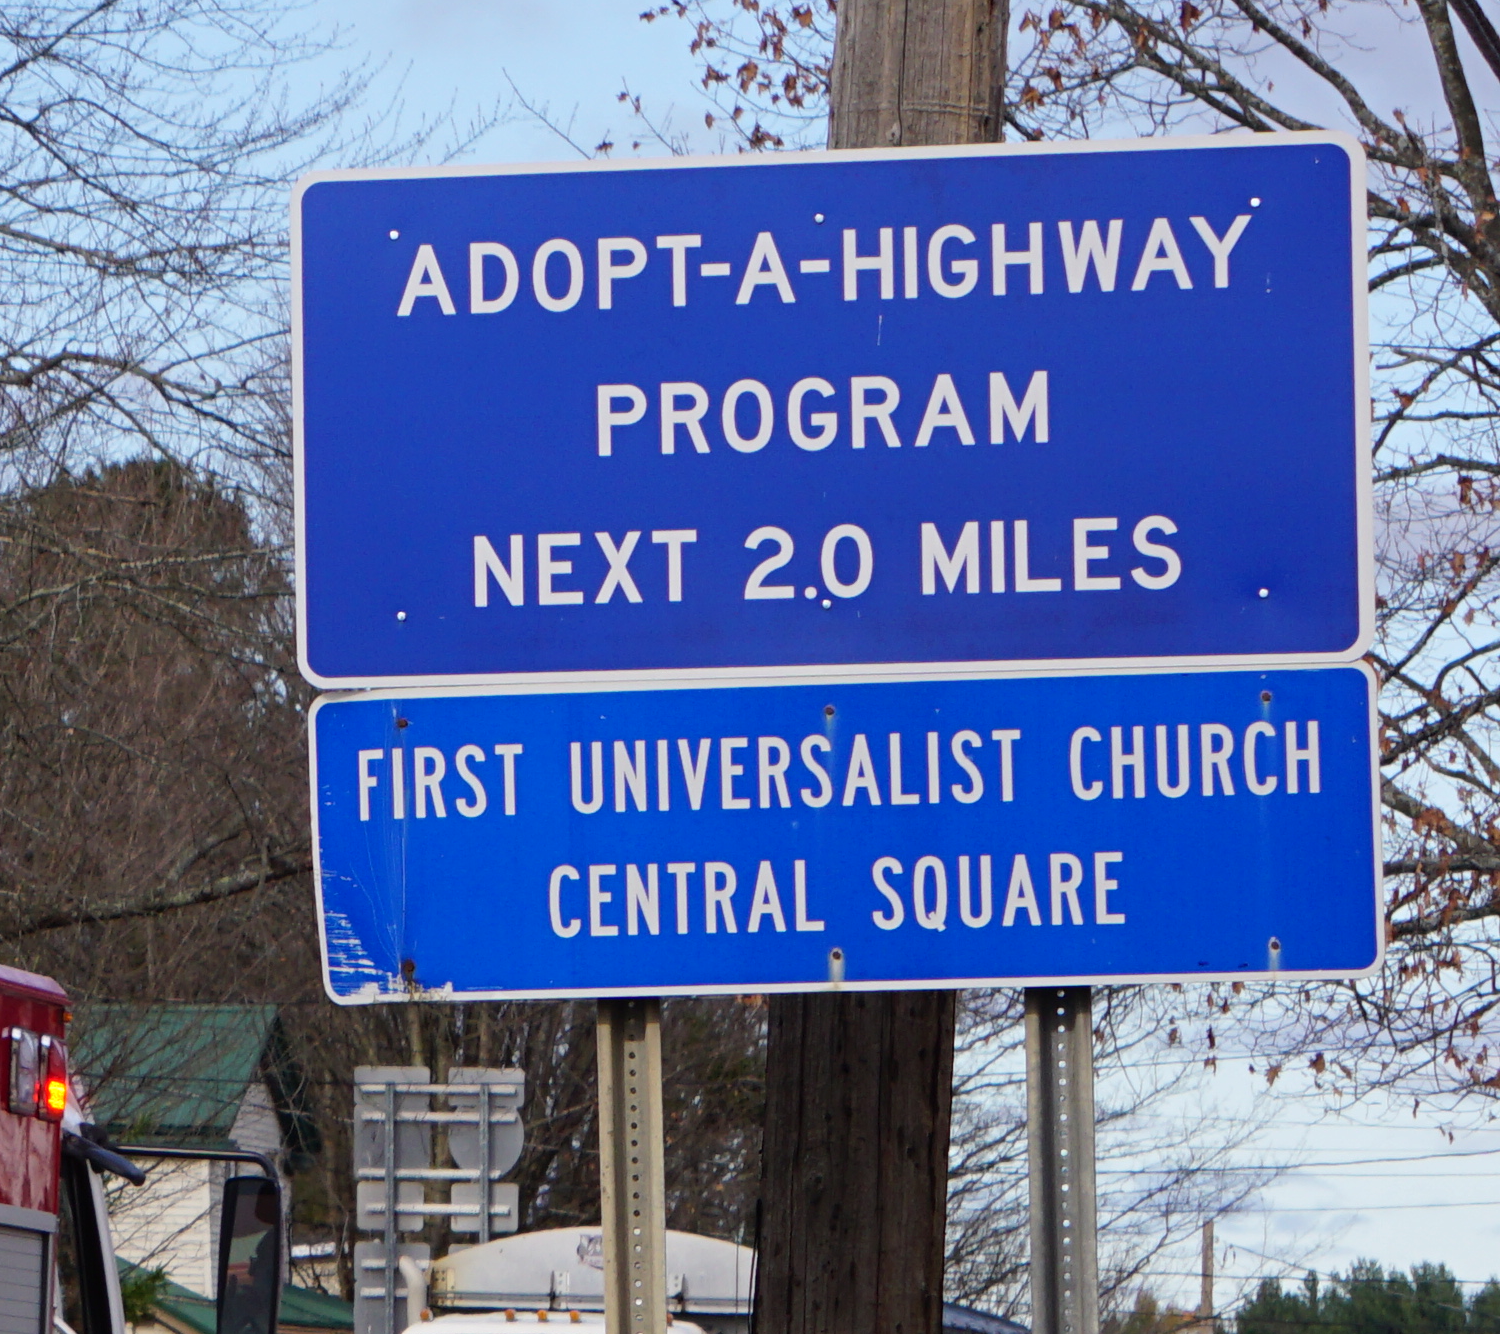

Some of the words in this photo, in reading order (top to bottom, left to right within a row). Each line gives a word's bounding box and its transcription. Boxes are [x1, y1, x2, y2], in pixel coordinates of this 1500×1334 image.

[397, 214, 1252, 317] ADOPT-A-HIGHWAY
[597, 370, 1049, 457] PROGRAM
[474, 529, 697, 608] NEXT
[744, 524, 873, 601] 2.0
[920, 515, 1182, 597] MILES
[358, 743, 524, 822] FIRST
[570, 729, 1021, 816] UNIVERSALIST
[1069, 720, 1321, 801] CHURCH
[549, 859, 825, 939] CENTRAL
[871, 851, 1126, 933] SQUARE
